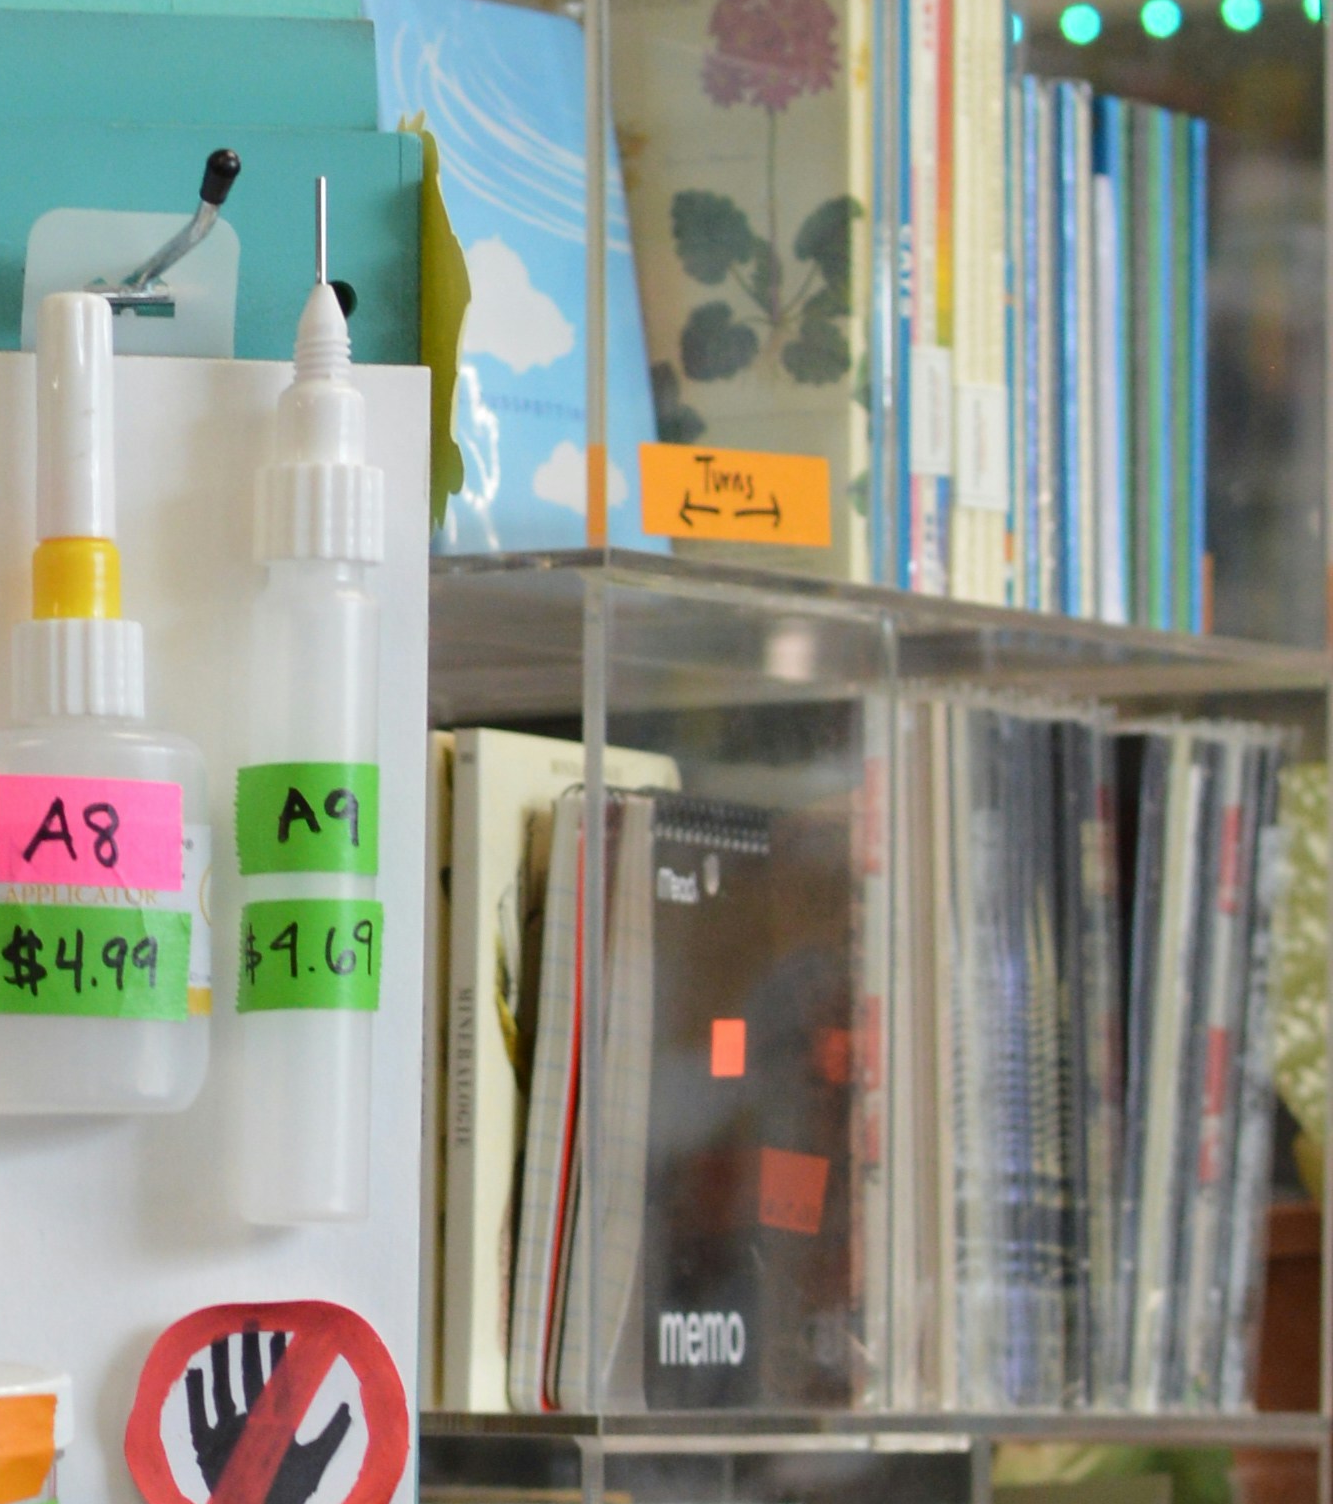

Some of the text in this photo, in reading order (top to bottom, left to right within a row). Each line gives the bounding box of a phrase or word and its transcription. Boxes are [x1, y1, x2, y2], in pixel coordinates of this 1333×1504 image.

[694, 455, 754, 500] Turns
[22, 796, 120, 869] A8
[277, 786, 360, 848] A9
[1, 924, 159, 997] $4.99
[244, 919, 374, 986] $4.69
[658, 1309, 747, 1368] memo
